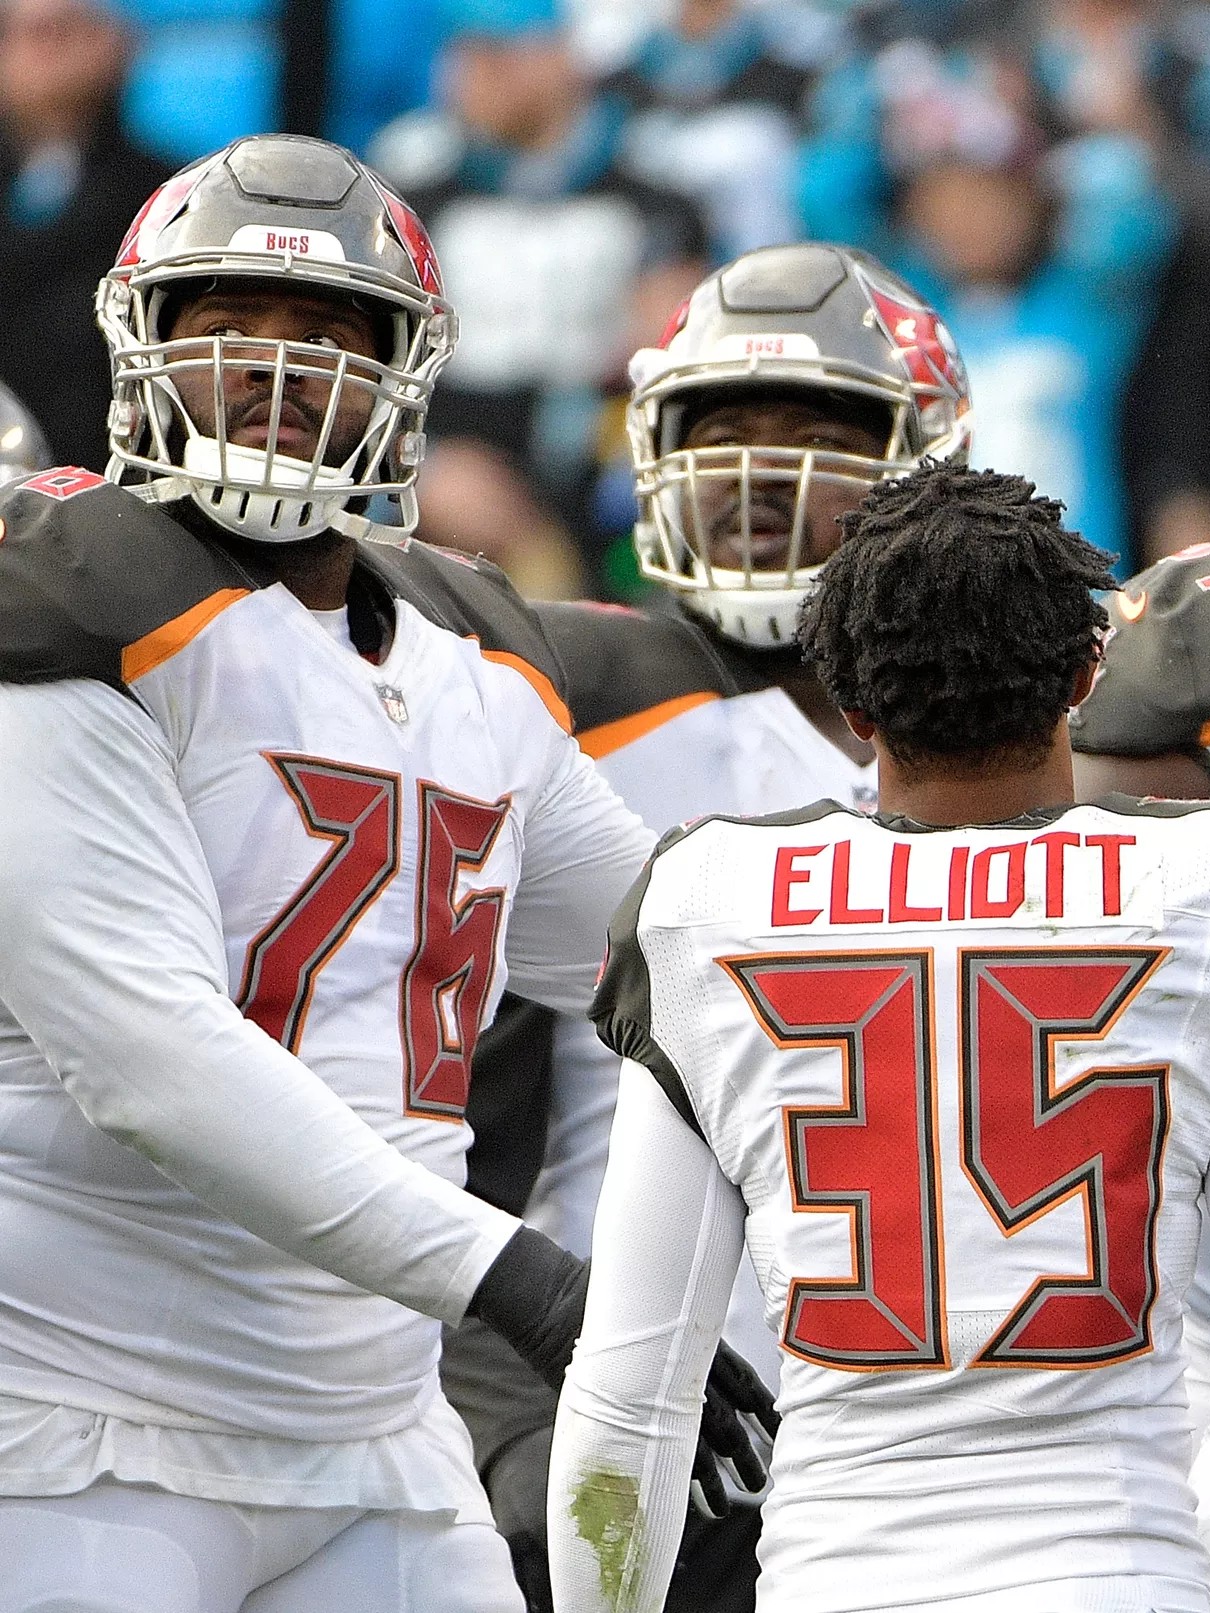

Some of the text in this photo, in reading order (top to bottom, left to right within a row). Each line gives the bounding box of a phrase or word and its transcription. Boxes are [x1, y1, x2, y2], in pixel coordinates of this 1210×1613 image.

[236, 751, 512, 1126] 76
[771, 831, 1137, 927] ELLIOTT
[712, 946, 1174, 1371] 35
